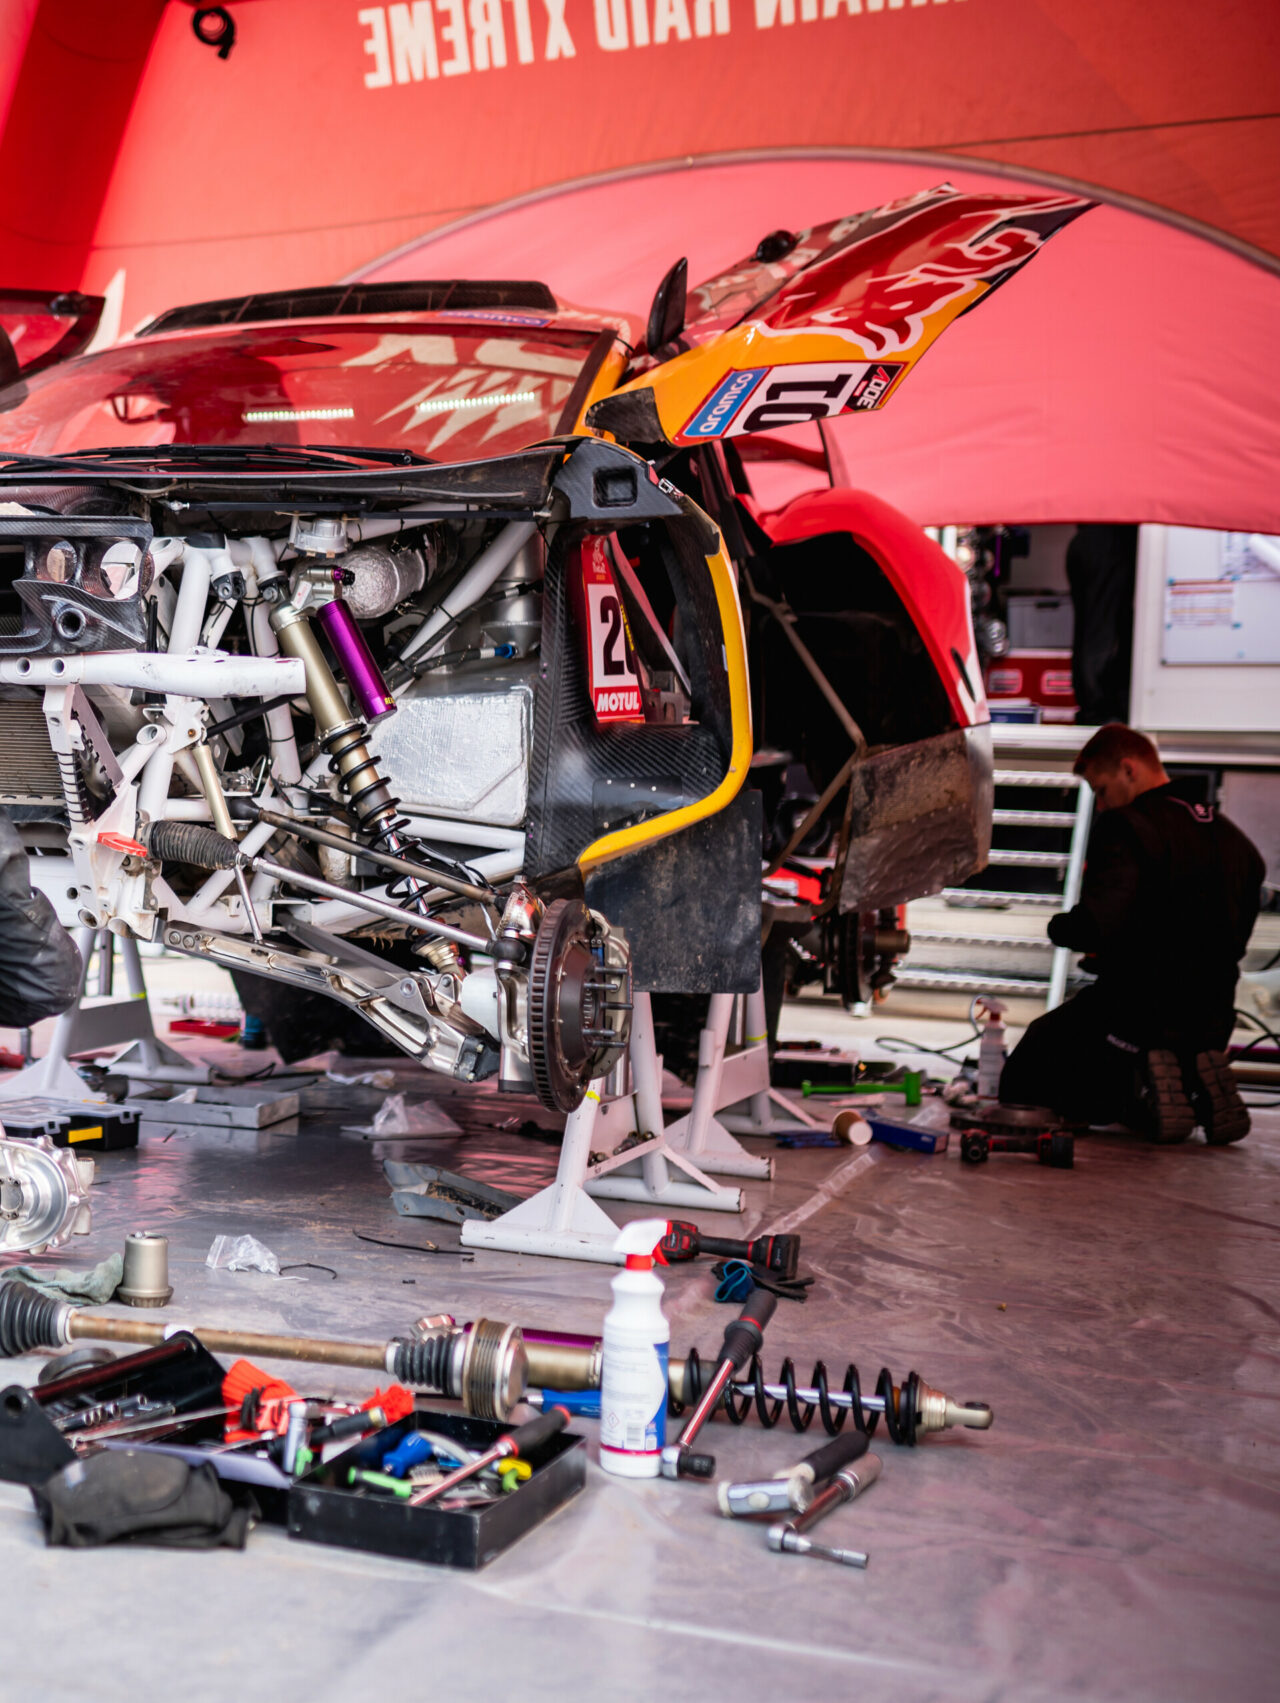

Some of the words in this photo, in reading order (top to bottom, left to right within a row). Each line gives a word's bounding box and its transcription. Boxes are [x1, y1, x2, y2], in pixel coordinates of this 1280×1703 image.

[699, 373, 754, 433] aramco
[857, 366, 891, 409] 300V
[597, 691, 639, 712] MOTUL
